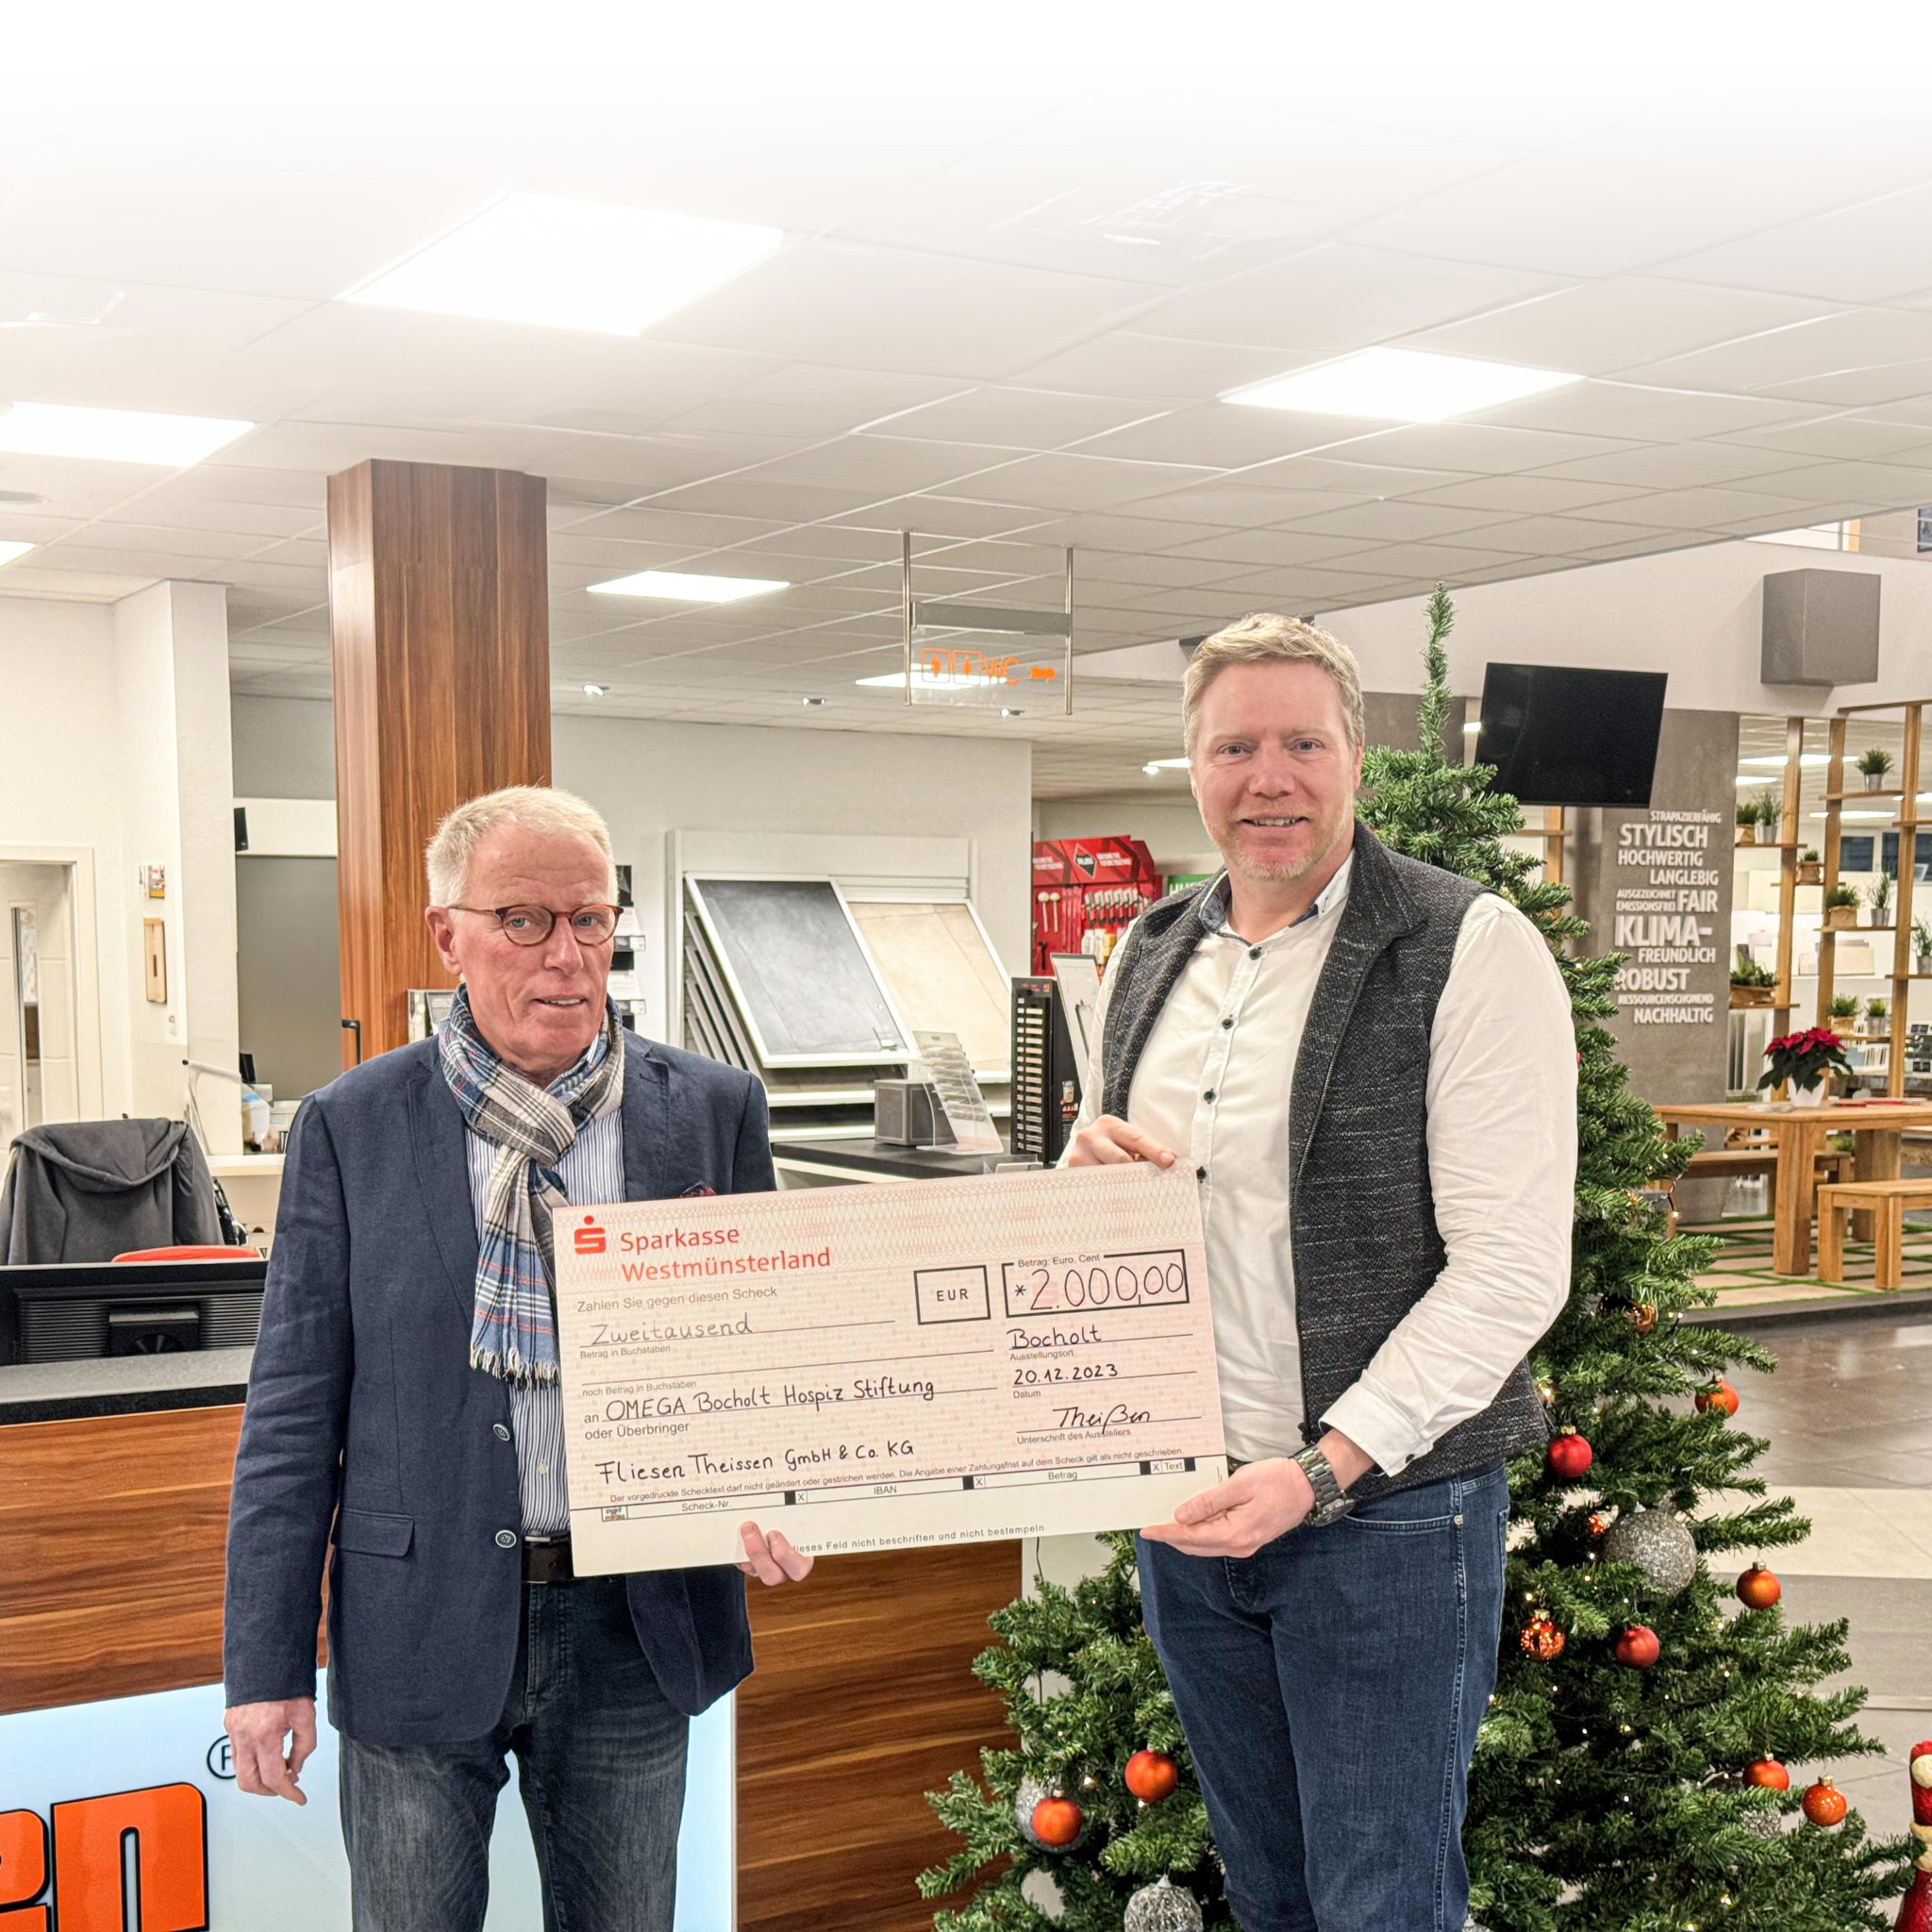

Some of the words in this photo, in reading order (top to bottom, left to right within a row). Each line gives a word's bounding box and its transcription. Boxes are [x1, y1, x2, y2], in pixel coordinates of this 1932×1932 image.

[985, 655, 1022, 686] WC
[1650, 808, 1721, 823] STRAPAZIERFÄHIG
[1618, 824, 1707, 848] STYLISCH
[1617, 849, 1703, 866] HOCHWERTIG
[1649, 869, 1719, 886] LANGLEBIG
[1616, 889, 1676, 899] AUSGEZEICHNET
[1676, 890, 1718, 912] FAIR
[1616, 901, 1675, 911] EMISSIONSFREI
[1614, 915, 1713, 947] KLIMA-
[1638, 947, 1716, 963] FREUNDLICH
[1613, 968, 1690, 991] ROBUST
[1634, 1008, 1713, 1024] NACHHALTIG
[621, 1228, 740, 1255] Sparkasse
[622, 1247, 830, 1282] Westmünsterland
[1018, 1257, 1049, 1268] Betrag:
[1079, 1254, 1100, 1263] Cent
[577, 1300, 619, 1312] Zahlen
[624, 1297, 642, 1308] Sie
[647, 1295, 684, 1309] gegen
[689, 1291, 728, 1303] diesen
[733, 1286, 776, 1300] Scheck
[936, 1289, 970, 1302] EUR
[590, 1312, 753, 1346] Zweitausend
[1007, 1324, 1102, 1349] Bocholt
[580, 1349, 608, 1359] Betrag
[610, 1348, 618, 1357] in
[621, 1344, 671, 1357] Buchstaben
[1009, 1349, 1074, 1361] Ausstellungsort
[1014, 1364, 1118, 1385] 20.12.2023
[582, 1389, 603, 1397] noch
[606, 1386, 634, 1395] Betrag
[636, 1384, 643, 1392] in
[646, 1380, 697, 1391] Buchstaben
[1013, 1391, 1041, 1399] Datum
[606, 1396, 687, 1422] OMEGA
[693, 1386, 770, 1413] Bocholt
[784, 1383, 844, 1412] Hospiz
[854, 1376, 935, 1401] Stiftung
[584, 1415, 599, 1424] an
[585, 1428, 613, 1441] oder
[616, 1422, 690, 1438] Überbringer
[1017, 1433, 1066, 1445] Unterschrift
[1068, 1432, 1083, 1441] des
[1085, 1427, 1131, 1440] Ausstellers
[594, 1460, 686, 1484] Fliesen
[687, 1453, 773, 1474] Theissen
[785, 1448, 831, 1471] GmbH
[839, 1445, 849, 1459] &
[856, 1444, 879, 1459] Co.
[887, 1440, 914, 1457] KG
[1153, 1463, 1160, 1473] X
[1164, 1461, 1184, 1472] Text
[610, 1493, 625, 1503] Der
[626, 1490, 679, 1502] vorgedruckte
[681, 1485, 724, 1496] Schecktext
[726, 1482, 742, 1492] darf
[744, 1481, 764, 1491] nicht
[765, 1479, 801, 1491] geändert
[802, 1477, 821, 1487] oder
[823, 1474, 863, 1486] gestrichen
[899, 1469, 913, 1478] Die
[914, 1466, 945, 1478] Angabe
[946, 1464, 967, 1474] einer
[969, 1459, 1019, 1472] Zahlungsfrist
[1021, 1458, 1034, 1468] auf
[1036, 1457, 1054, 1467] dem
[1055, 1455, 1085, 1466] Scheck
[1086, 1453, 1098, 1463] gilt
[1100, 1452, 1111, 1461] als
[1113, 1450, 1132, 1460] nicht
[975, 1477, 983, 1487] X
[1047, 1470, 1078, 1481] Betrag
[797, 1492, 805, 1502] X
[874, 1485, 897, 1496] IBAN
[681, 1499, 731, 1512] Scheck-Nr.
[826, 1540, 848, 1550] Feld
[851, 1538, 875, 1548] nicht
[879, 1533, 935, 1545] beschriften
[938, 1531, 957, 1541] und
[959, 1528, 985, 1539] nicht
[988, 1524, 1044, 1537] bestempeln
